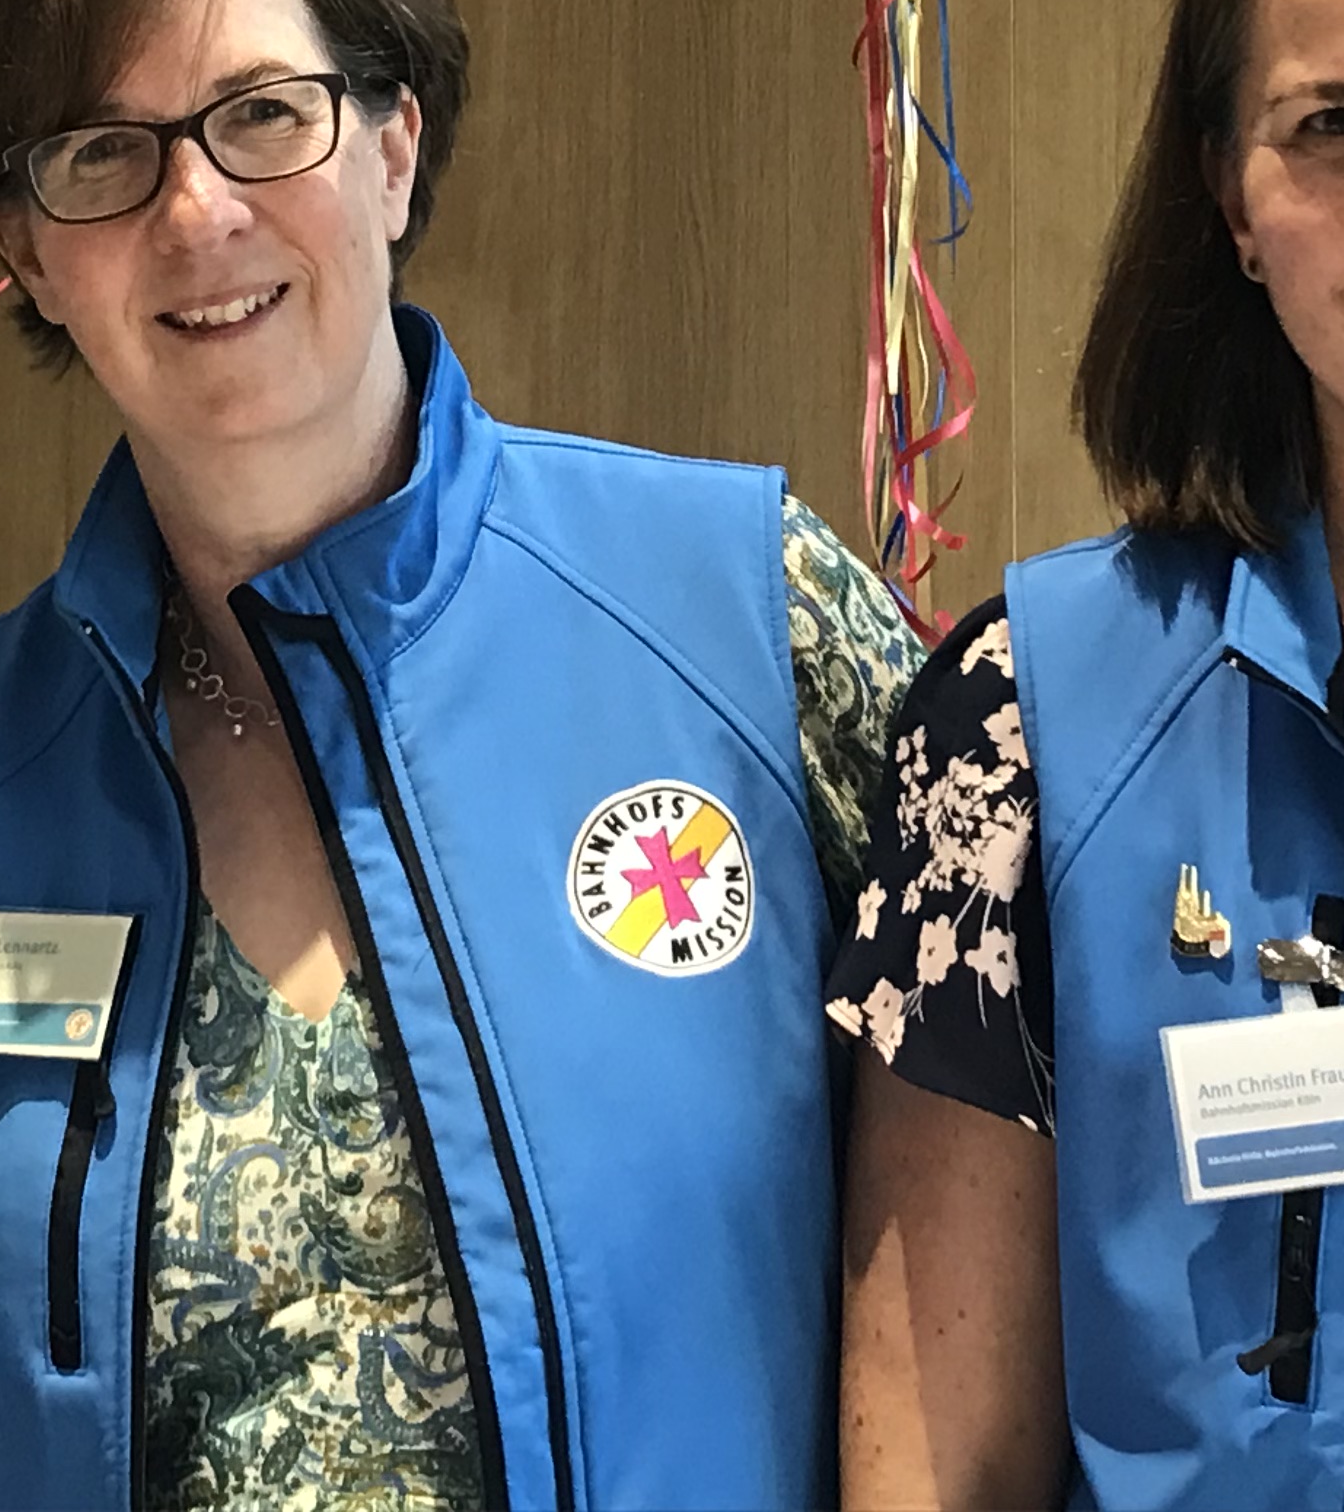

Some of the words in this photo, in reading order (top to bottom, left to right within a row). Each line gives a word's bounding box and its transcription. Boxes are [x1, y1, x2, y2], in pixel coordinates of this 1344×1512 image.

[580, 794, 685, 920] BAHNHOFS
[670, 864, 745, 965] MISSION
[1198, 1083, 1234, 1101] Ann
[1237, 1074, 1306, 1096] Christin
